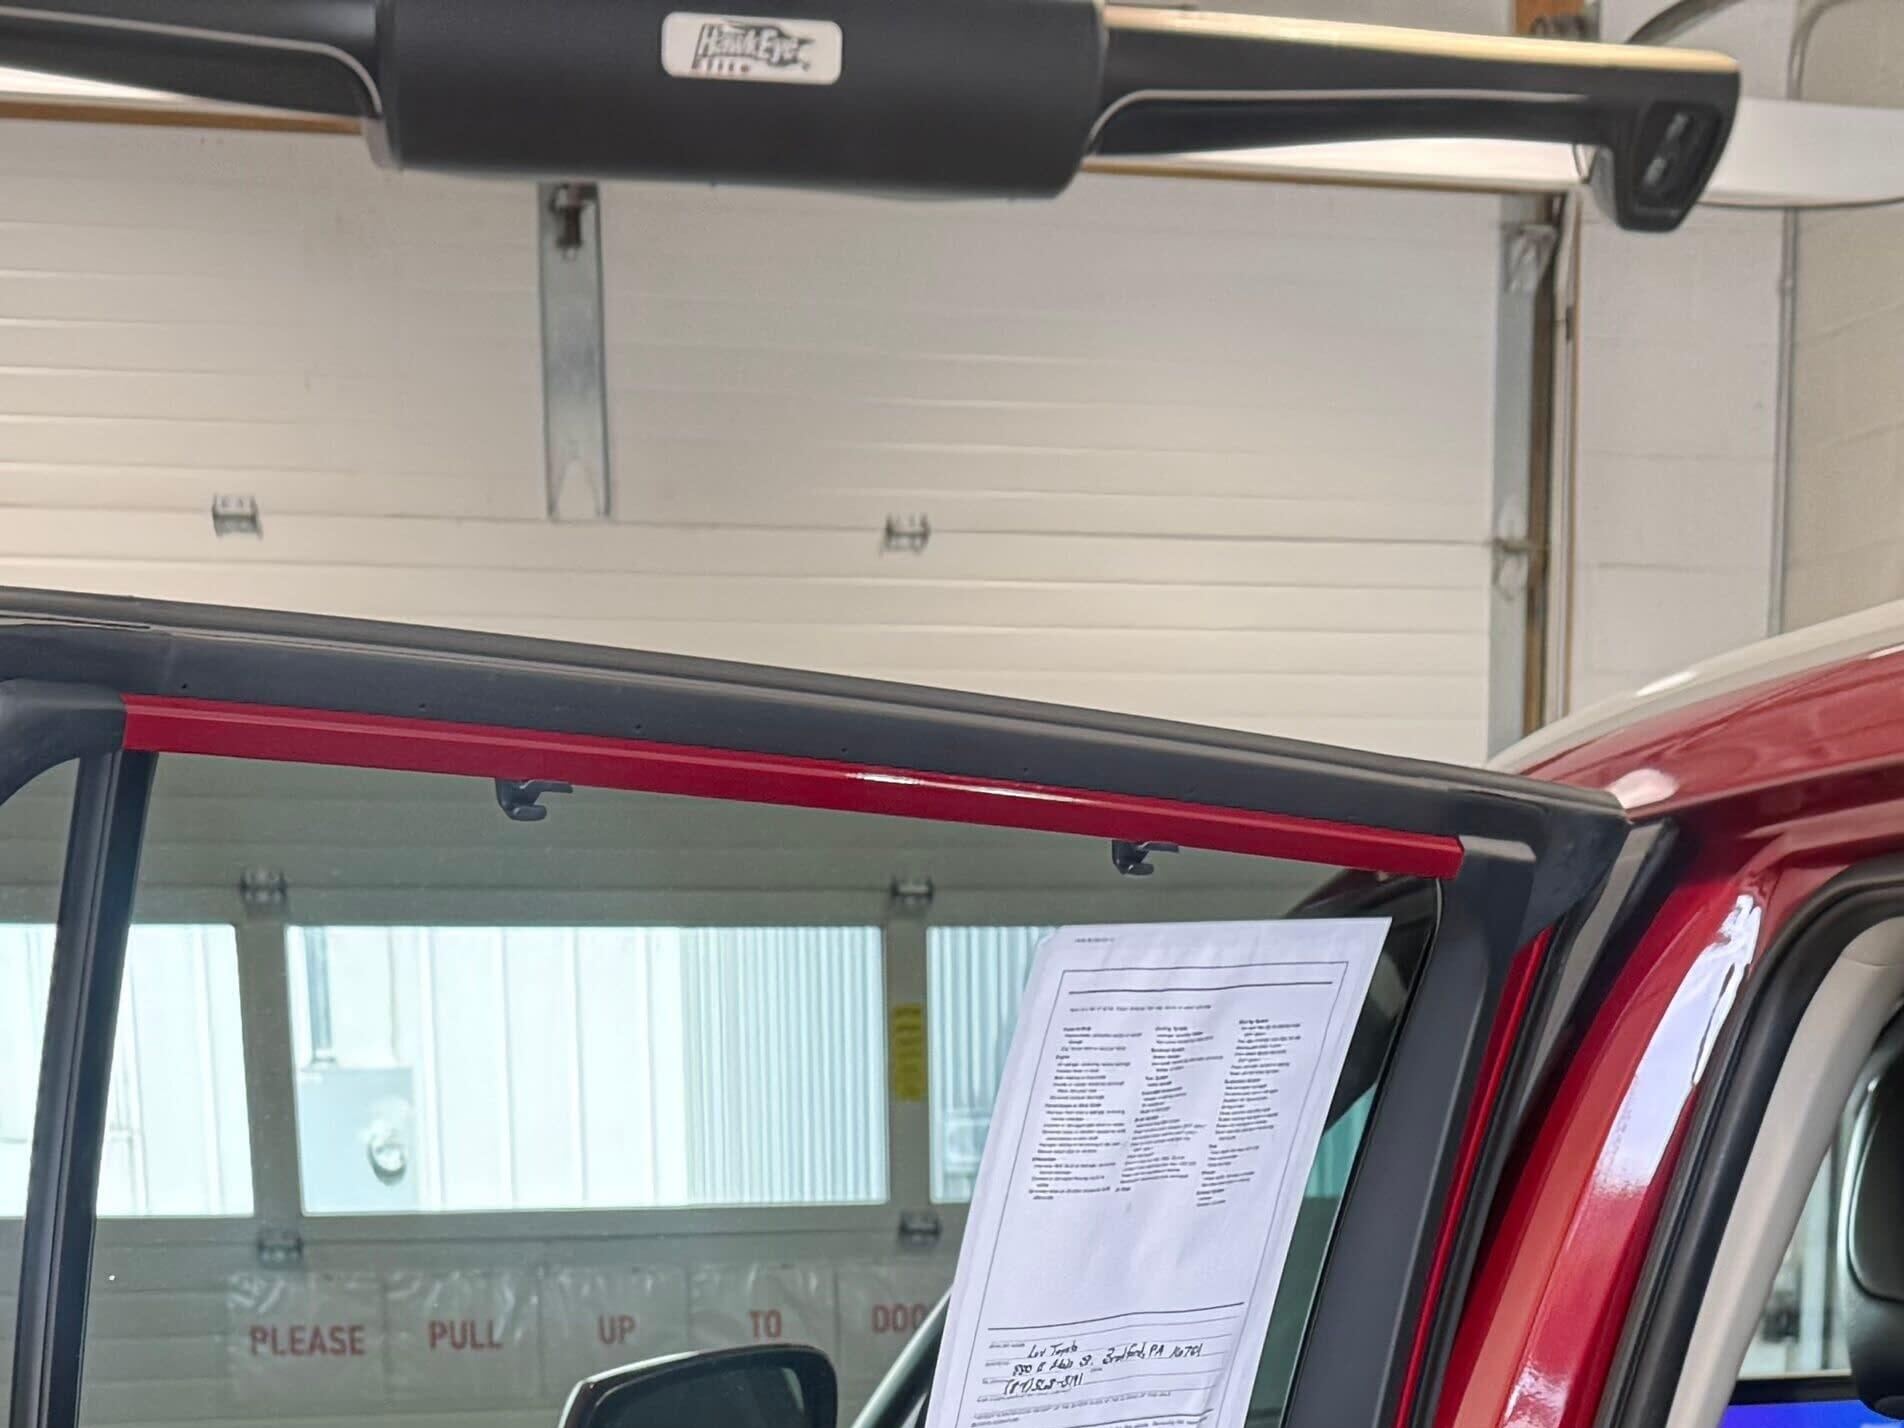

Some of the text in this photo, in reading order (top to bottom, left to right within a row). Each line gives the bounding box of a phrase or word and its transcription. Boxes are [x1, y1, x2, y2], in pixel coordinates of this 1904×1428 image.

[249, 1322, 367, 1357] PLEASE
[427, 1318, 504, 1351] PULL
[598, 1313, 637, 1345] UP
[748, 1308, 784, 1340] TO
